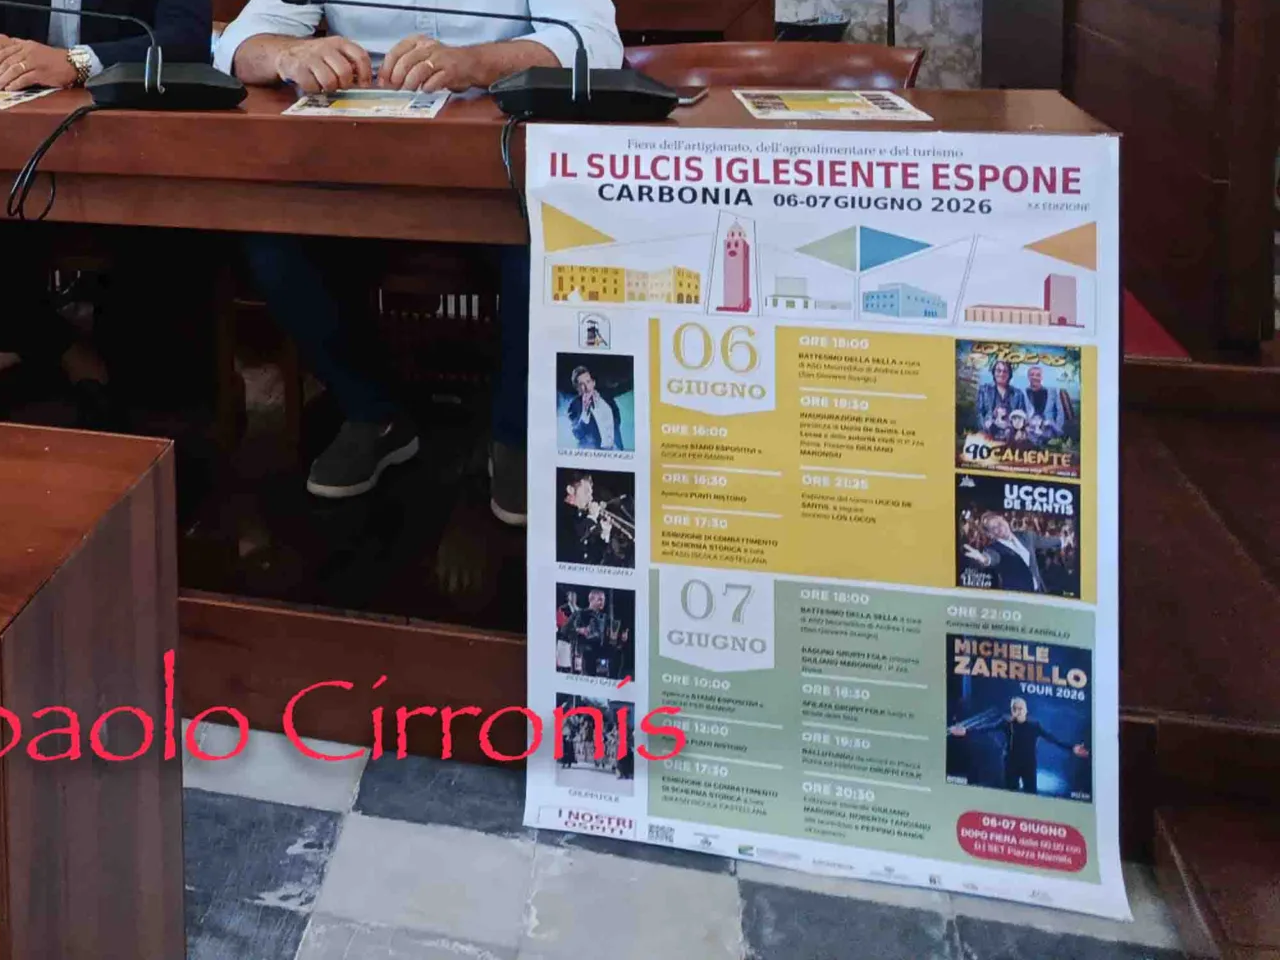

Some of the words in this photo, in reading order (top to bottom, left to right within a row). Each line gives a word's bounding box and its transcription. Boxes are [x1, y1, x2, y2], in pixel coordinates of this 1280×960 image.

[627, 139, 656, 151] Fiera
[755, 141, 876, 159] dell'agroalimentare
[913, 146, 964, 158] turismo
[549, 152, 577, 178] IL
[586, 153, 704, 183] SULCIS
[714, 156, 920, 191] IGLESIENTE
[931, 163, 1082, 196] ESPONE
[598, 183, 754, 207] CARBONIA
[773, 193, 832, 209] 06-07
[833, 195, 922, 212] GIUGNO
[930, 196, 993, 215] 2026
[672, 322, 762, 375] 06
[666, 378, 767, 399] GIUGNO
[991, 447, 1072, 467] CALIENTE
[1004, 483, 1073, 505] UCCIO
[1004, 499, 1020, 510] DE
[1025, 501, 1073, 516] SANTIS
[664, 515, 689, 525] ORE
[680, 578, 755, 623] 07
[800, 589, 830, 601] ORE
[834, 591, 869, 605] 18:00
[946, 605, 976, 618] ORE
[981, 608, 1022, 621] 22:00
[666, 629, 768, 654] GIUGNO
[954, 638, 1049, 663] MICHELE
[662, 673, 689, 685] ORE
[694, 676, 731, 690] 10:00
[953, 655, 1088, 689] ZARRILLO
[802, 684, 830, 695] ORE
[1020, 682, 1053, 696] TOUR
[1056, 689, 1085, 701] 2026
[802, 732, 830, 744] ORE
[664, 760, 691, 772] ORE
[802, 782, 832, 795] ORE
[835, 785, 875, 802] 20:30
[558, 808, 562, 818] I
[568, 810, 632, 829] NOSTRI
[982, 816, 1016, 830] 06-07
[1019, 822, 1067, 837] GIUGNO
[960, 827, 987, 840] DOPO
